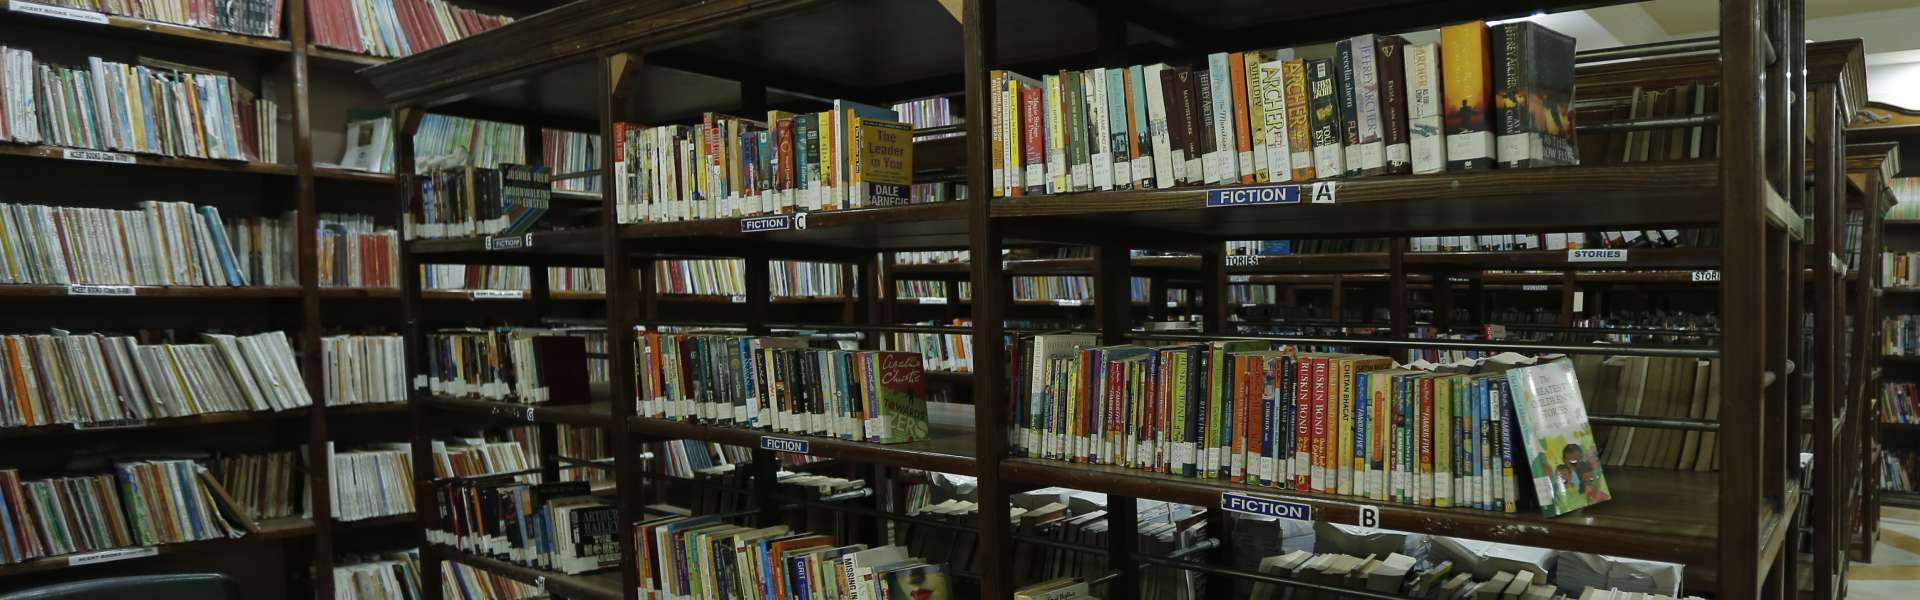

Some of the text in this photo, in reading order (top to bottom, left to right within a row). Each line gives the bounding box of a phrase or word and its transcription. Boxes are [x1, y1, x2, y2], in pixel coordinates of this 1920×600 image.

[1285, 62, 1307, 129] ARCHER
[1344, 82, 1354, 108] ahern
[1361, 45, 1377, 131] JEFFREY ARCHER
[1261, 67, 1285, 132] ARCHER
[877, 129, 896, 143] The
[1346, 119, 1358, 145] FLAW
[867, 143, 905, 157] Leader
[882, 157, 903, 170] You
[875, 184, 899, 197] DALE
[1220, 188, 1287, 204] FICTION
[1316, 184, 1332, 201] A
[869, 194, 911, 207] ARNEGIE
[746, 218, 784, 230] FICTION
[796, 215, 804, 230] C
[495, 238, 520, 249] FICTION
[1226, 256, 1260, 267] TORIES
[1574, 250, 1621, 258] STORIES
[1695, 272, 1721, 281] STORI
[1343, 364, 1351, 393] CHETAN
[1298, 361, 1309, 434] RUSKIN BOND
[1314, 362, 1325, 435] RUSKIN BOND
[1501, 416, 1511, 442] FAMOUS
[766, 439, 802, 452] FICTION
[1231, 497, 1303, 519] FICTION
[1363, 508, 1376, 528] B
[797, 560, 806, 580] GRIT
[844, 558, 857, 591] MISSING
